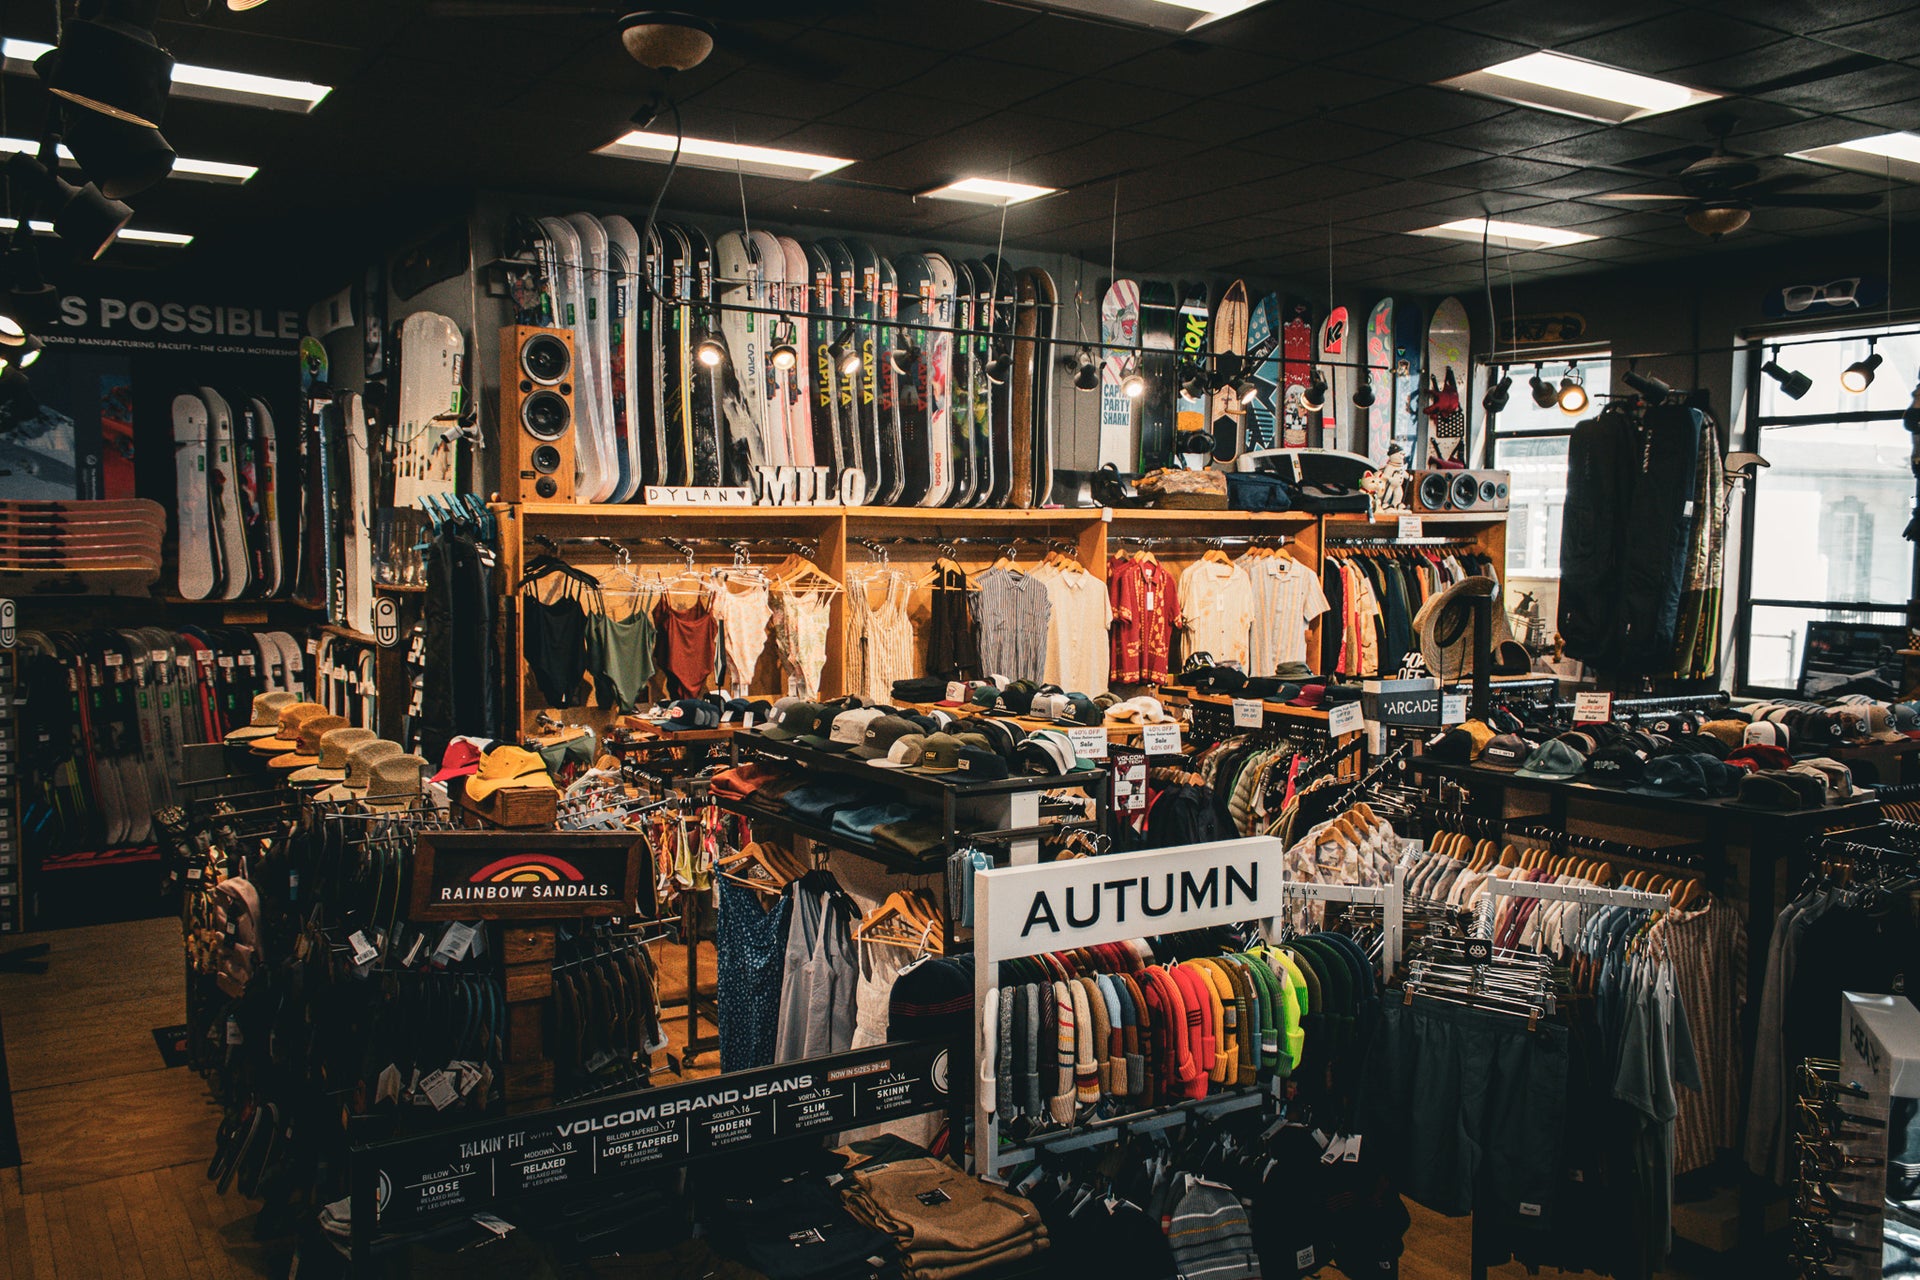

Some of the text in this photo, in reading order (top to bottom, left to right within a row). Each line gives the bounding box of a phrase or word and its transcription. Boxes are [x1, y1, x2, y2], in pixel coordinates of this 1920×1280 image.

[50, 296, 299, 339] S POSSIBLE
[1326, 320, 1343, 348] K2
[78, 338, 155, 349] MANUFACTURING
[157, 342, 192, 351] FACILITY
[1103, 398, 1130, 412] PARTY
[1103, 412, 1130, 426] SHARK!
[649, 488, 728, 501] DYLAN
[756, 466, 867, 507] MILO
[1388, 699, 1438, 715] ARCADE
[441, 884, 609, 900] RAINBOW SANDALS
[1020, 861, 1258, 938] AUTUMN
[830, 1071, 846, 1079] NOW
[853, 1066, 871, 1075] SIZES
[798, 1088, 831, 1101] VORTA 15
[877, 1084, 911, 1099] SKINNY
[508, 1131, 526, 1149] FIT
[556, 1105, 656, 1137] VOLCOM
[660, 1090, 739, 1118] BRAND
[742, 1074, 813, 1100] JEANS
[712, 1105, 750, 1119] SOLVER 16
[802, 1102, 825, 1114] SLIM
[606, 1120, 676, 1142] BILLOW TAPERED 17
[710, 1118, 752, 1134] MODERN
[524, 1142, 572, 1160] MODOWN 18
[602, 1133, 679, 1157] LOOSE TAPERED
[422, 1163, 471, 1181] BILLOW 19
[523, 1158, 566, 1175] RELAXED
[421, 1181, 460, 1197] LOOSE
